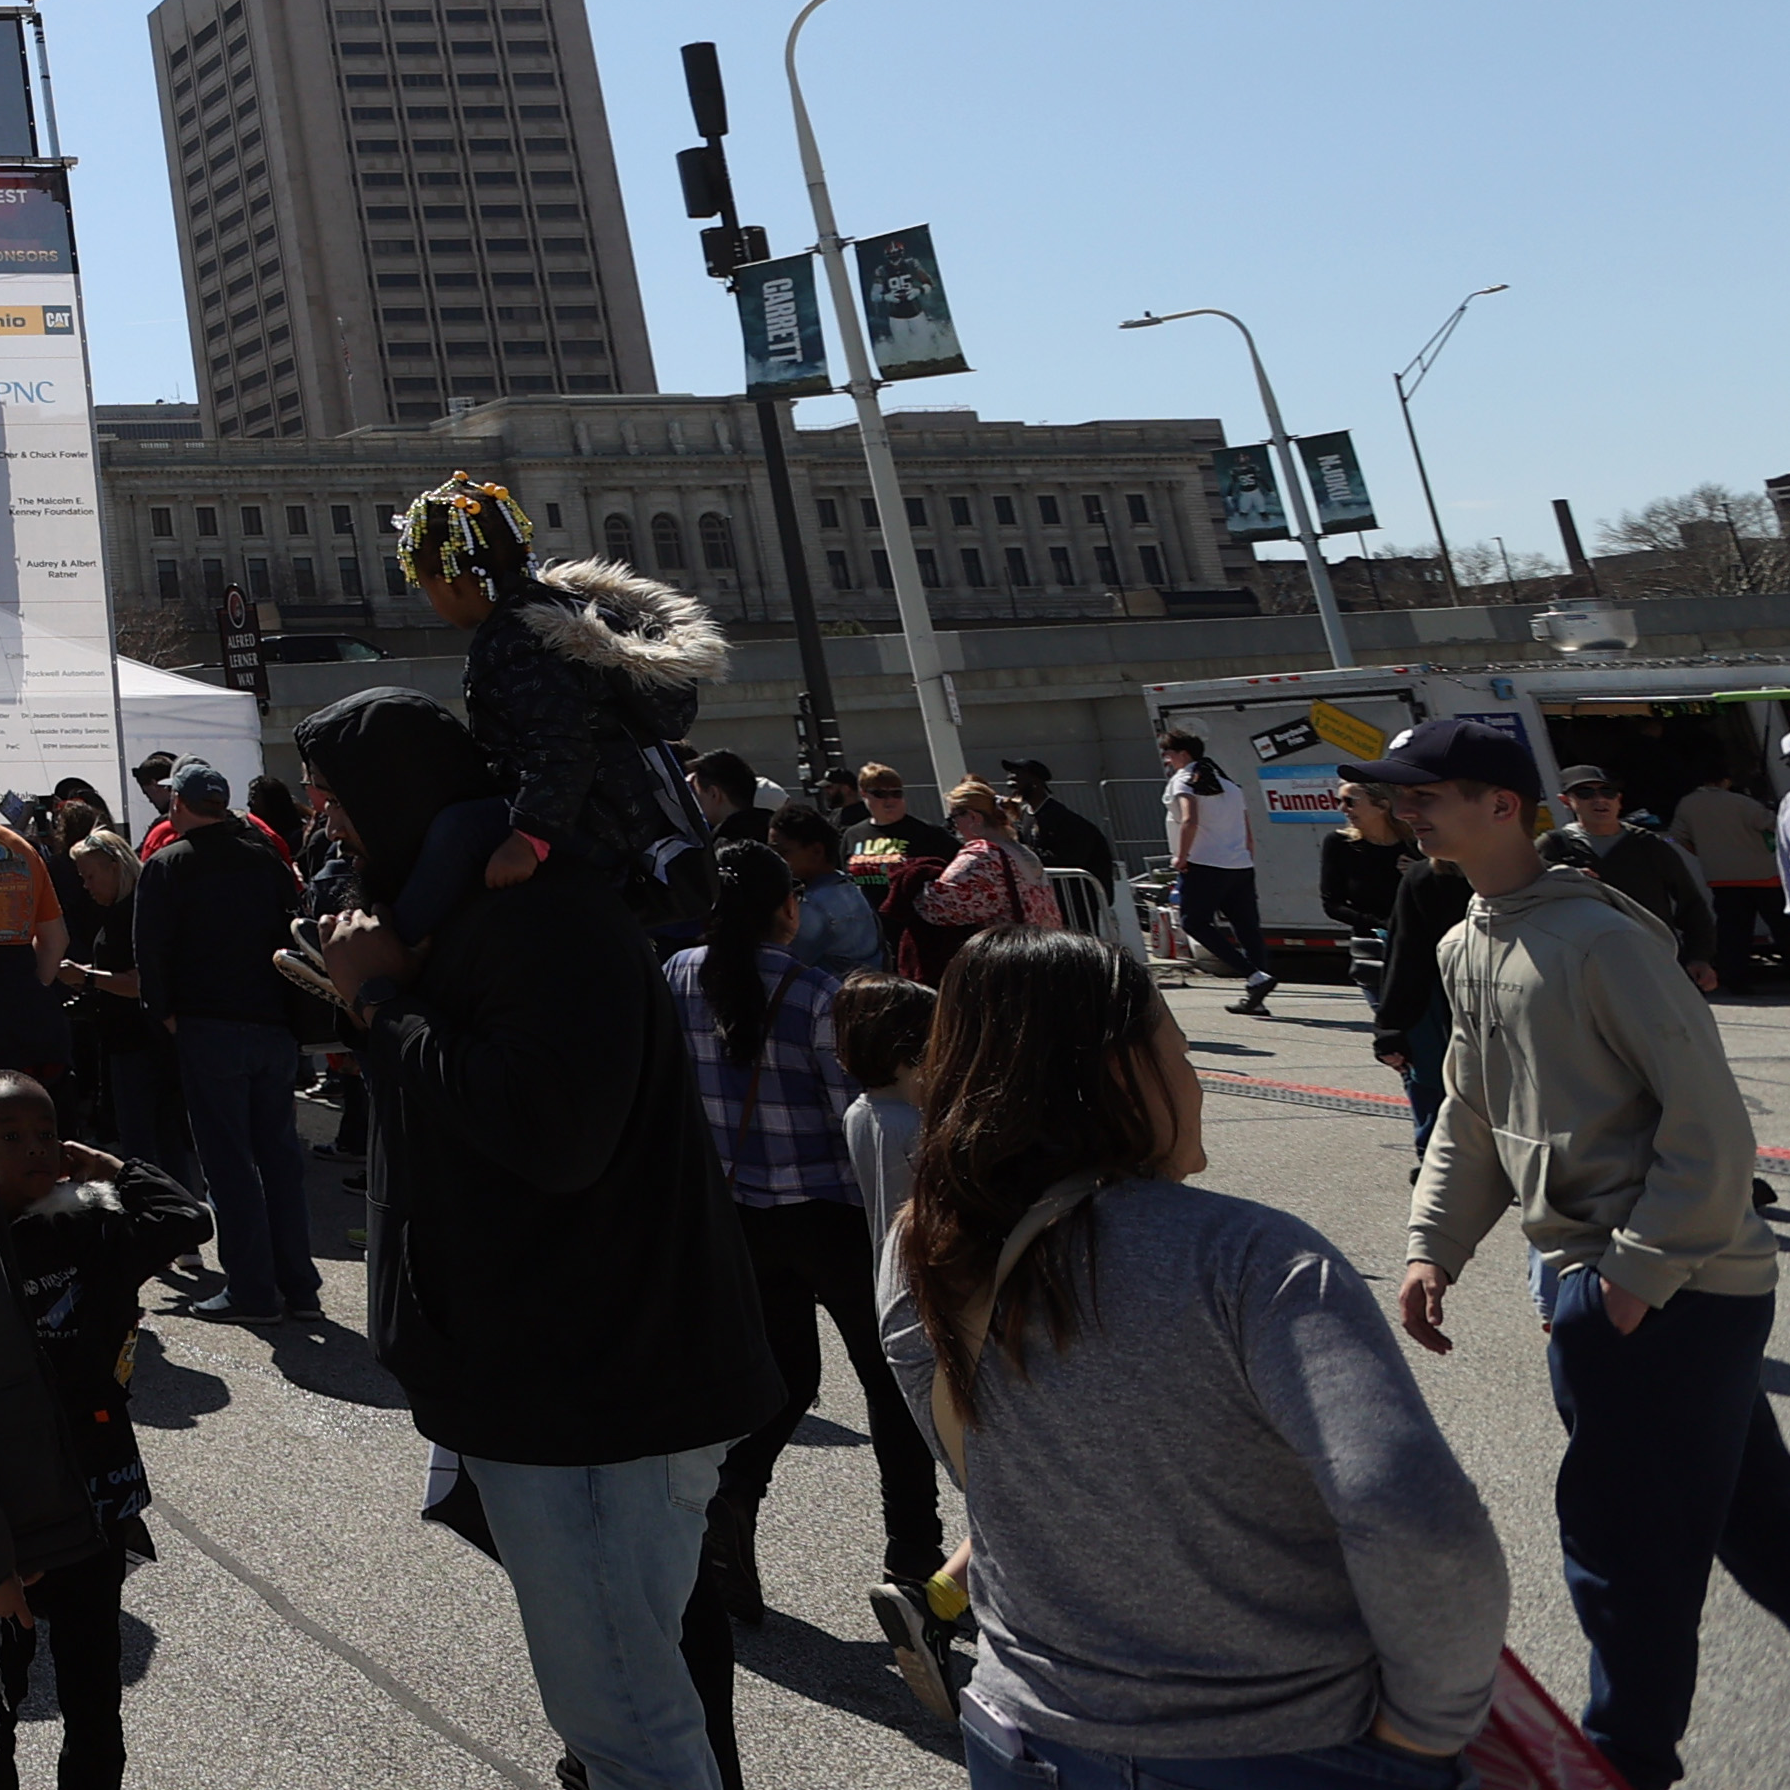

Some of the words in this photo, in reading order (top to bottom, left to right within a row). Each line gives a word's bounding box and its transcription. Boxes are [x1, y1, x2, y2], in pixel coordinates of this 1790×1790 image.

[46, 313, 70, 328] CAT
[762, 278, 803, 362] GARRETT
[30, 451, 57, 459] Chuck
[60, 451, 88, 459] Fowler
[1317, 454, 1352, 501] NJOKU
[10, 508, 41, 517] Kenney
[44, 508, 94, 516] Foundation
[27, 560, 58, 569] Audrey
[62, 560, 68, 568] &
[72, 560, 96, 568] Albert
[228, 634, 255, 649] ALFRED
[229, 653, 259, 668] LERNER
[237, 673, 255, 686] WAY
[1268, 790, 1337, 810] Funnel
